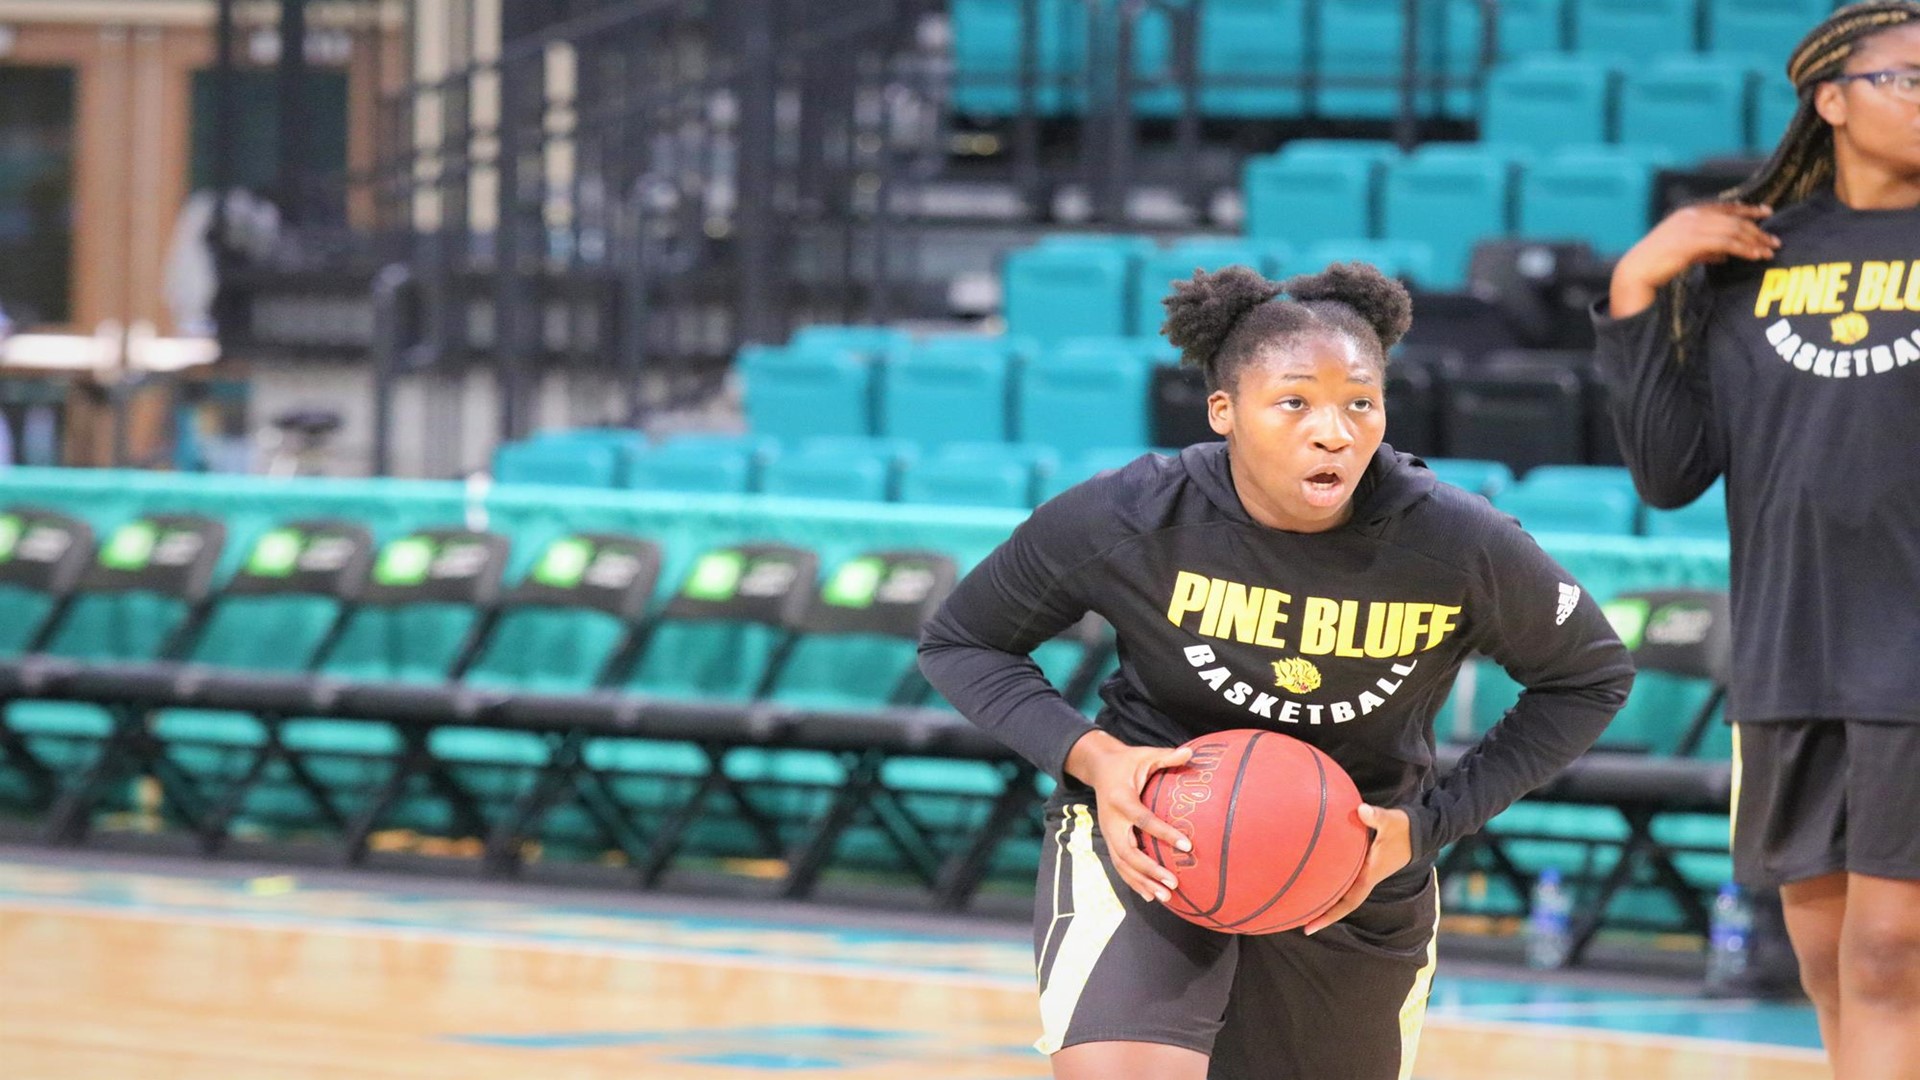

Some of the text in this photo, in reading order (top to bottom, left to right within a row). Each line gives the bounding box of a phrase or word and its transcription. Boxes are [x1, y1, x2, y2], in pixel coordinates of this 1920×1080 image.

[1754, 261, 1852, 318] PINE
[1167, 570, 1462, 659] PINE BLUFF
[1183, 643, 1418, 725] BASKETBALL
